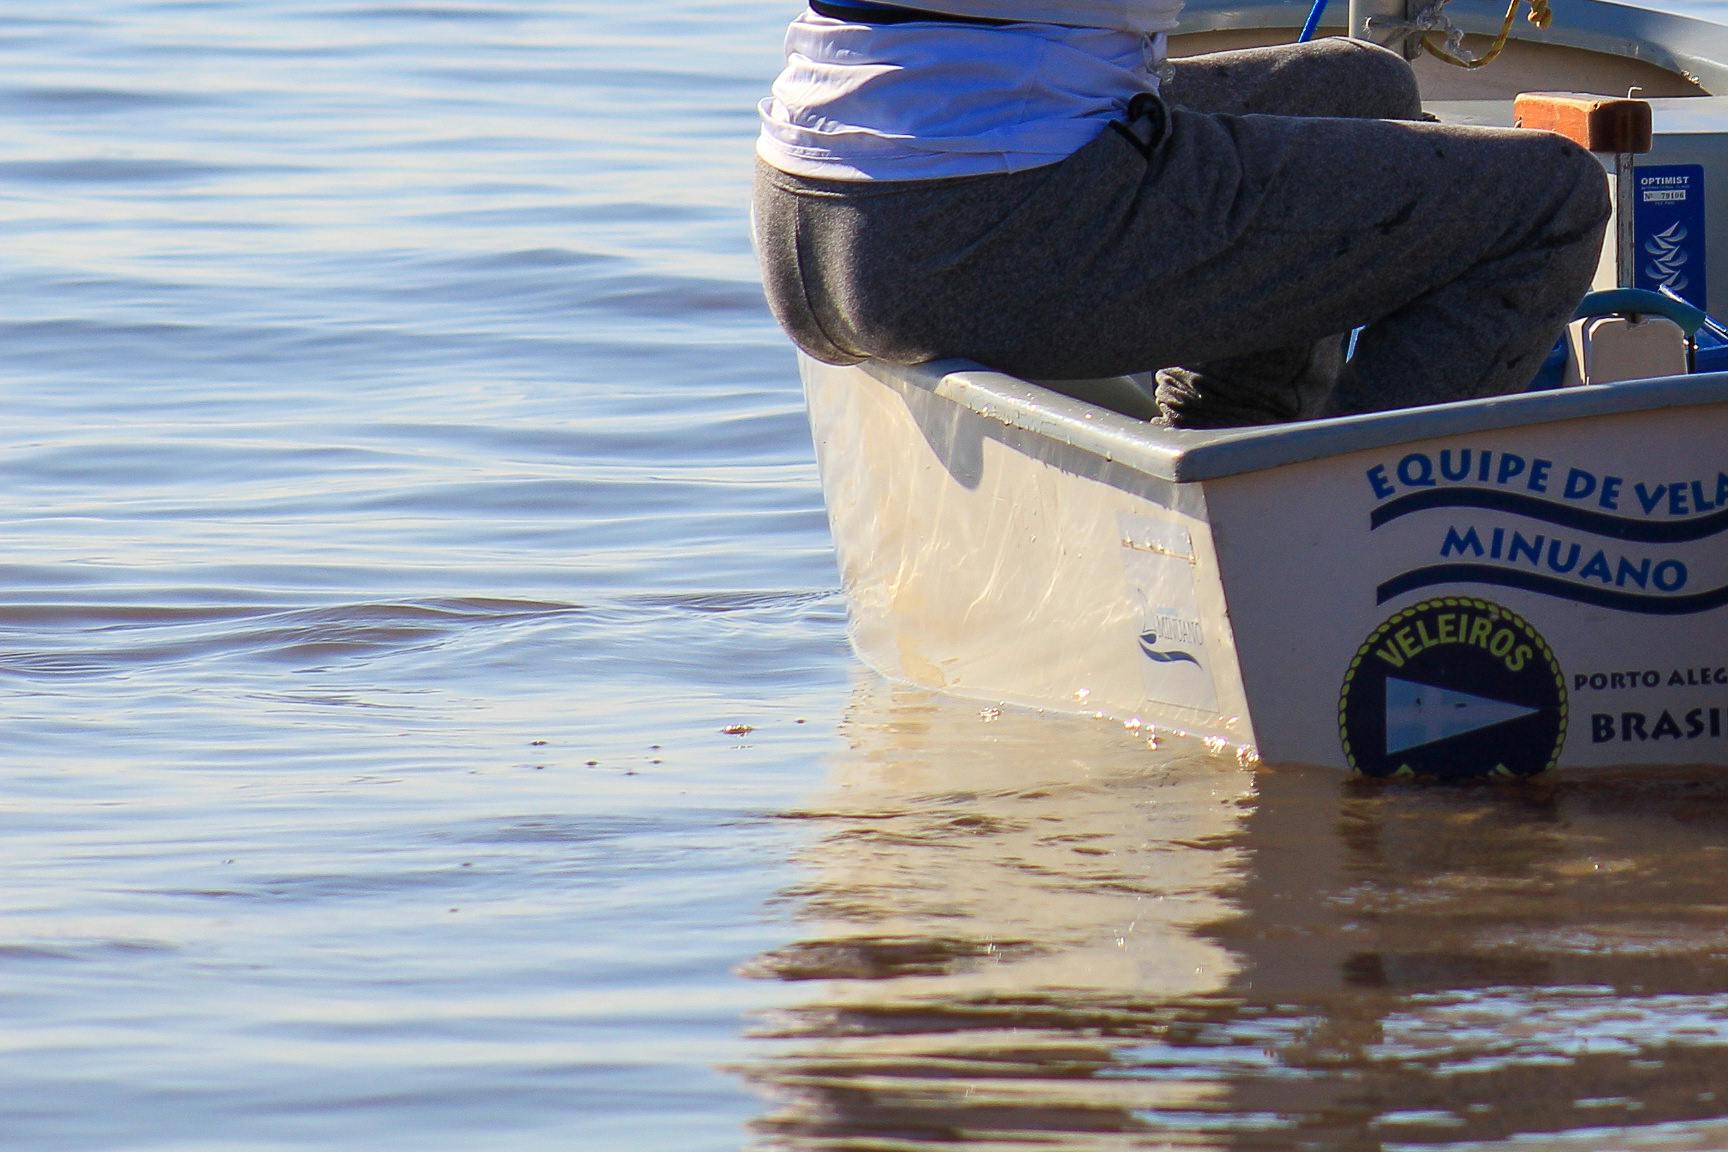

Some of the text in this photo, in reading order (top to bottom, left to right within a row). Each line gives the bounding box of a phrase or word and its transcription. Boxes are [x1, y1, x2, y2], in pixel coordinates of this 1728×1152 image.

[1641, 176, 1690, 185] OPTIMIST
[1366, 448, 1552, 501] EQUIPE
[1563, 467, 1624, 511] DE
[1439, 525, 1689, 592] MINUANO
[1376, 612, 1534, 673] VELEIROS
[1574, 670, 1660, 691] PORTO
